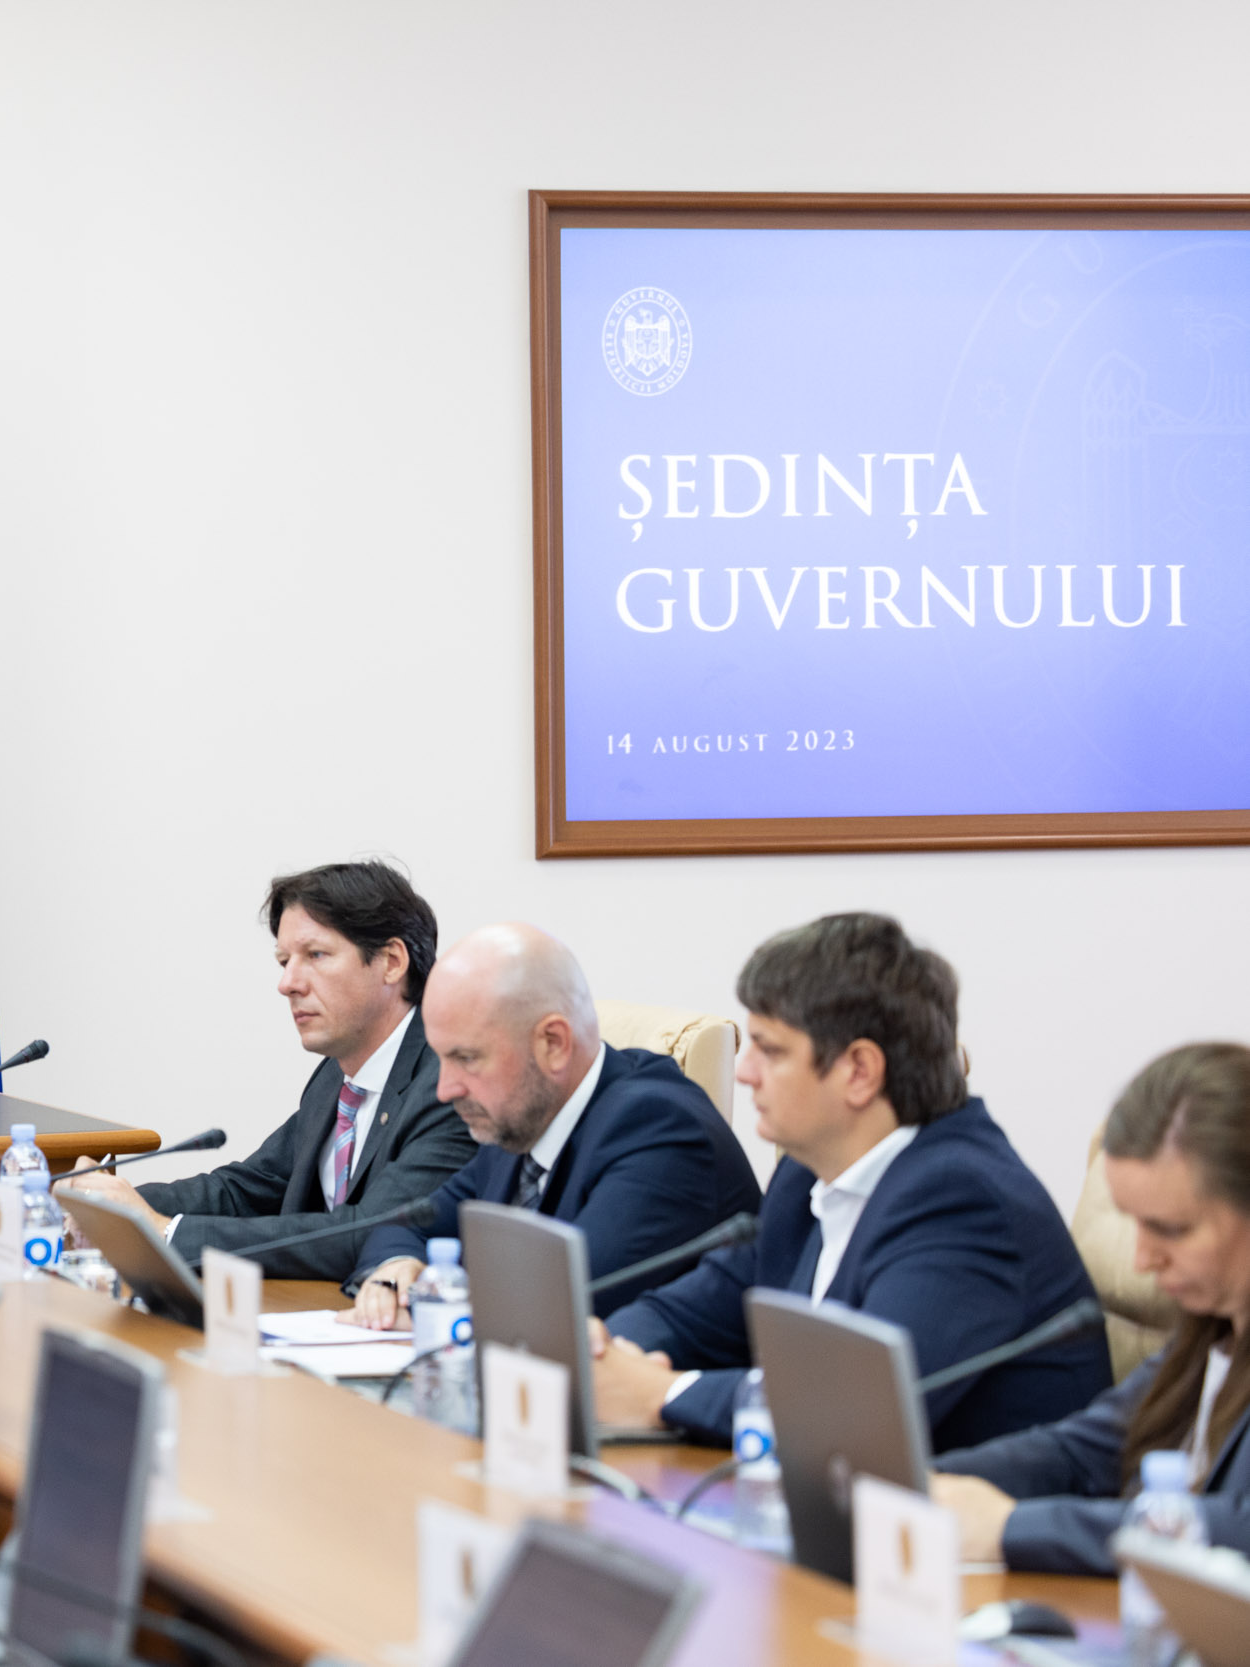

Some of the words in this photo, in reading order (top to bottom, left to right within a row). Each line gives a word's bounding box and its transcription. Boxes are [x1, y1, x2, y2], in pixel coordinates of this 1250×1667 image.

[617, 452, 989, 542] ȘEDINȚA
[615, 564, 1188, 633] GUVERNULUI
[607, 732, 633, 756] 14
[652, 733, 769, 755] AUGUST
[785, 729, 856, 752] 2023
